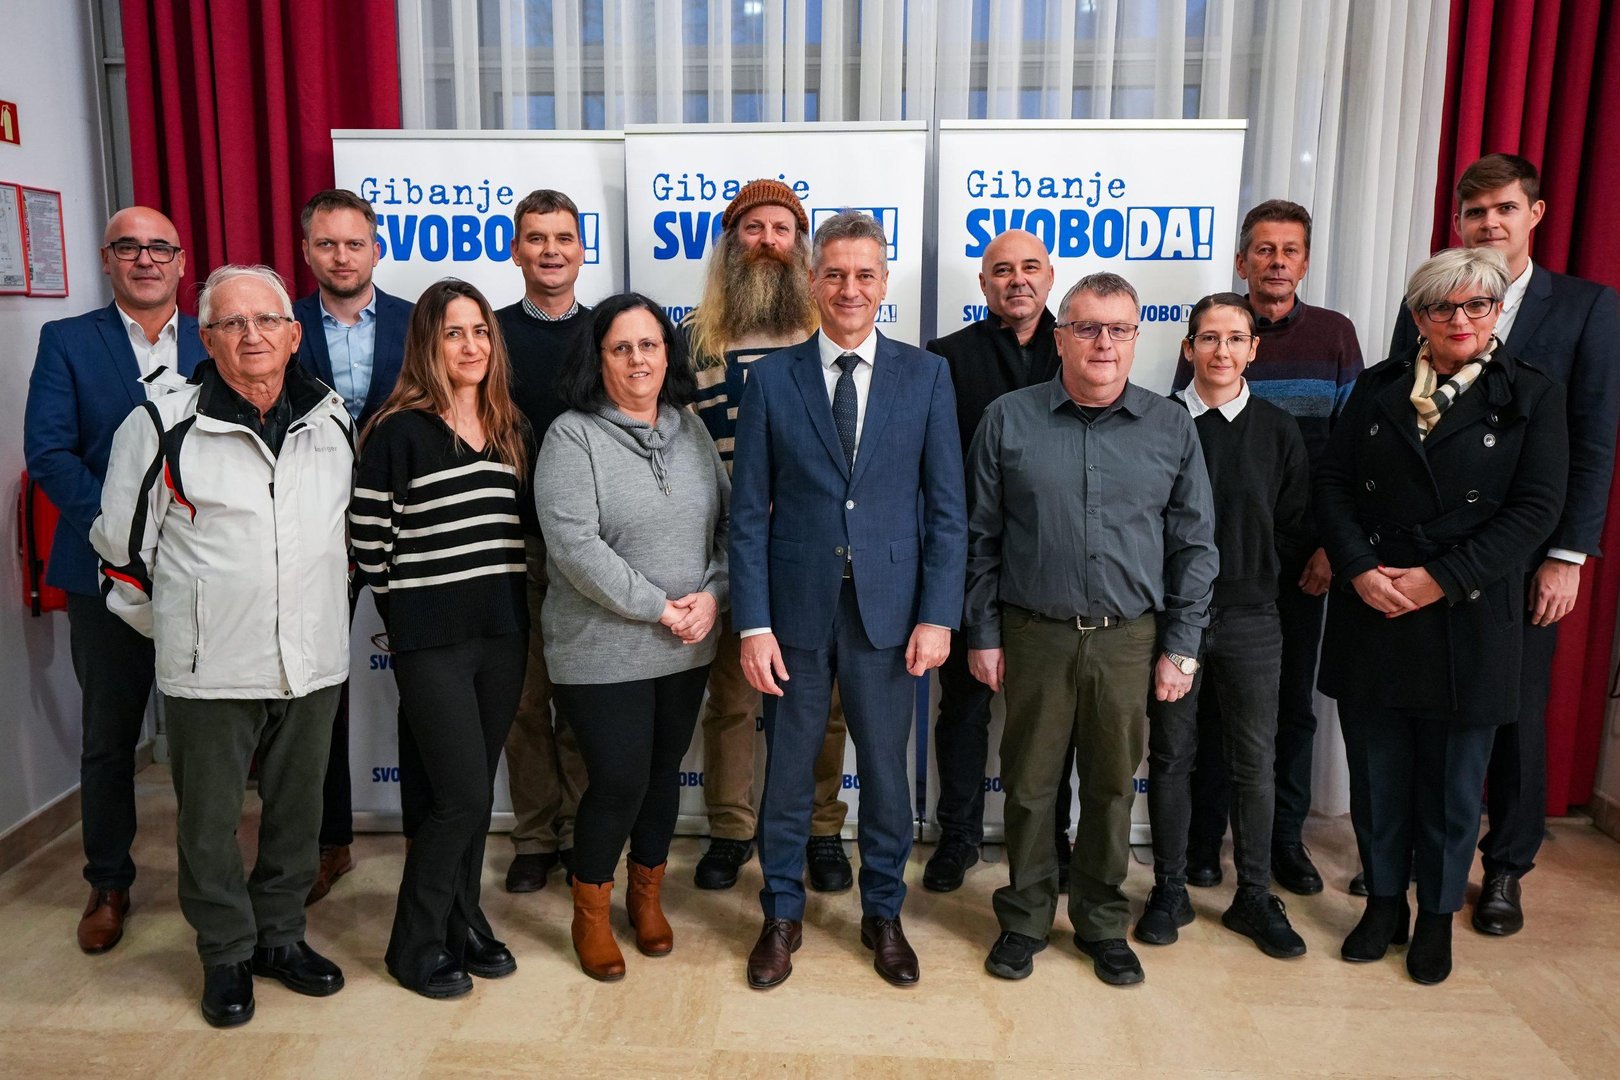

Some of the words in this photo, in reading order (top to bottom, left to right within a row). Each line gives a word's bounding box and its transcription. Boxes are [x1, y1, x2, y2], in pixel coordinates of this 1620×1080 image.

[361, 177, 514, 213] Gibanje
[653, 173, 809, 200] Gibae
[967, 169, 1126, 207] Gibanje
